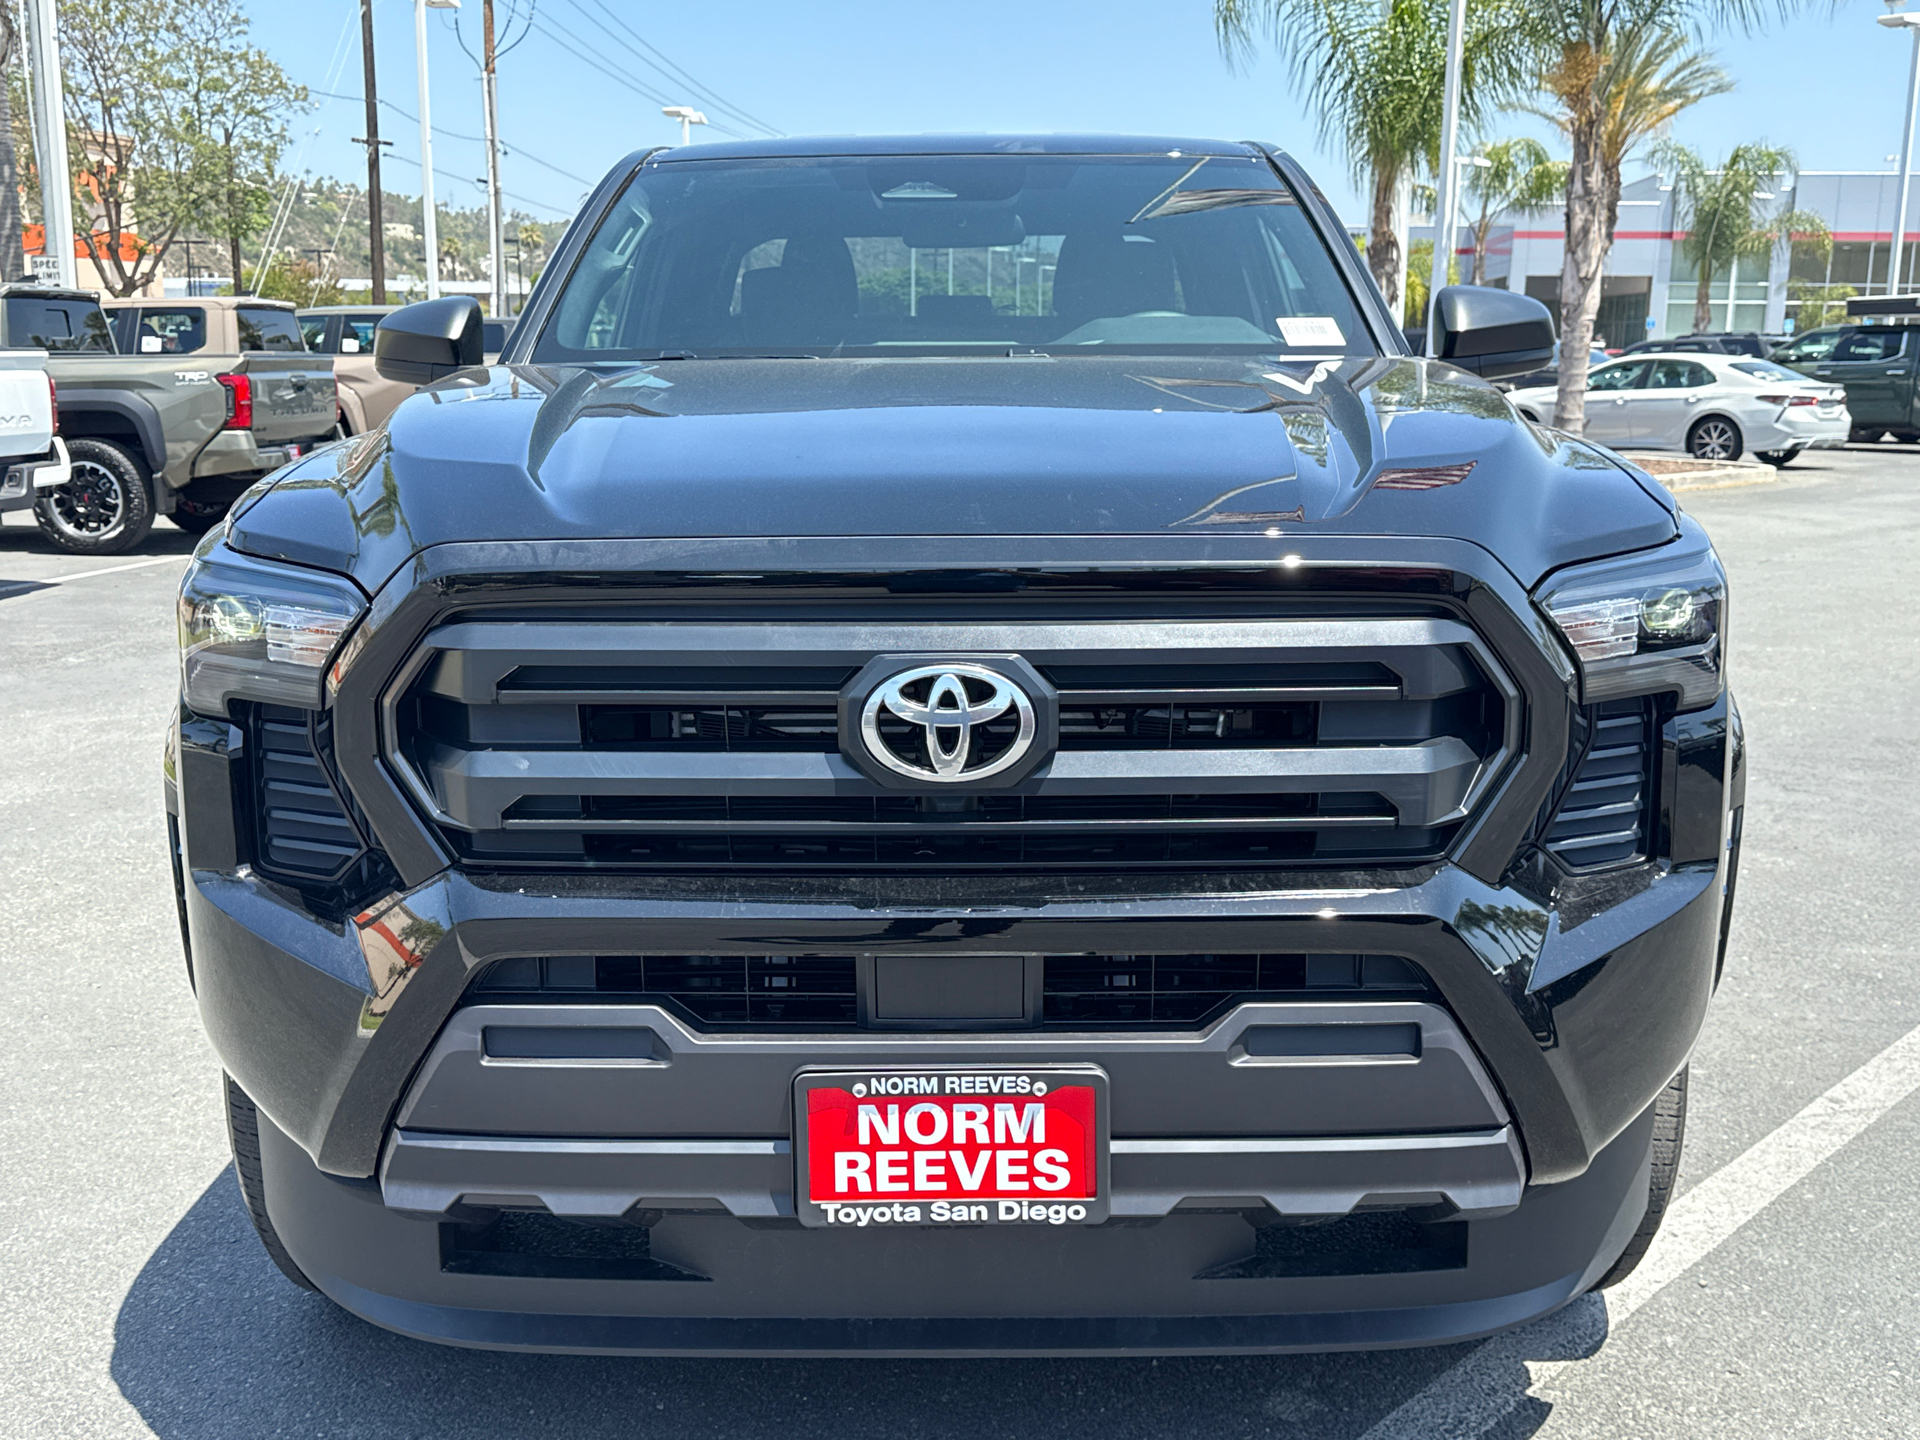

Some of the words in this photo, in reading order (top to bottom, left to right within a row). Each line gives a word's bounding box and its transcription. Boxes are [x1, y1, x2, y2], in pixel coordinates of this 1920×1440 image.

[33, 259, 58, 269] SPEE
[174, 371, 209, 381] TRD
[870, 1077, 938, 1095] NORM
[944, 1076, 1032, 1094] REEVES
[857, 1102, 1046, 1146] NORM
[834, 1149, 1071, 1193] REEVES
[820, 1203, 921, 1227] Toyota
[930, 1201, 988, 1221] San
[998, 1201, 1087, 1225] Diego
